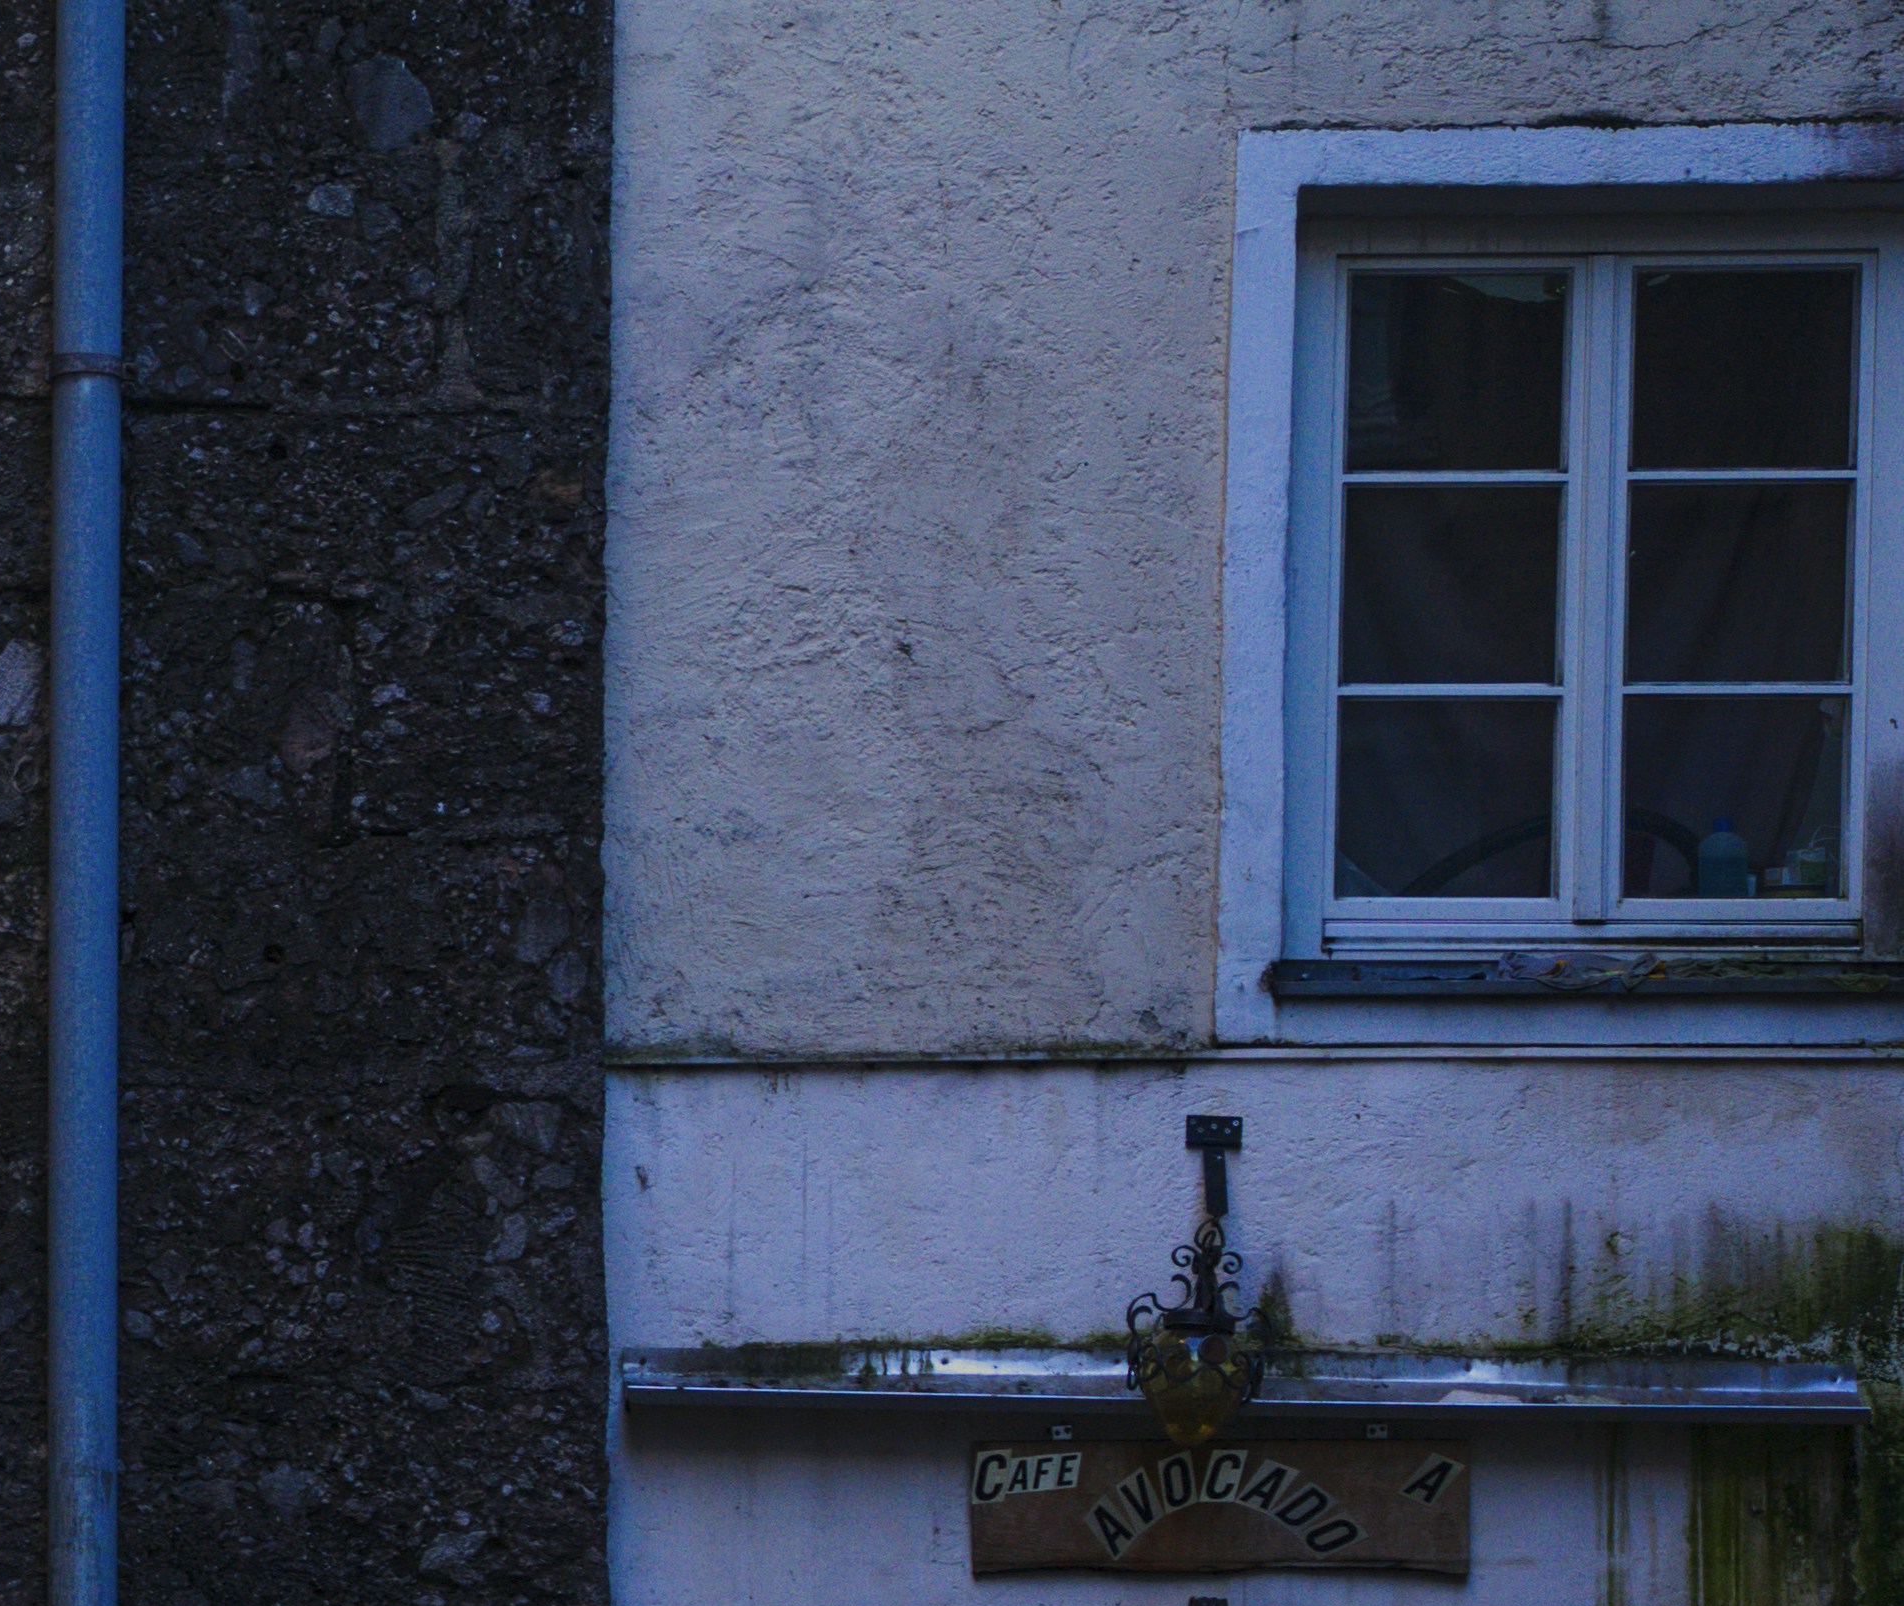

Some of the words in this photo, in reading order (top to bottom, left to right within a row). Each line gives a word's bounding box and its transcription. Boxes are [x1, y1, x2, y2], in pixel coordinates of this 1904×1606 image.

[974, 1452, 1078, 1502] CAFE
[1402, 1458, 1453, 1504] A
[1092, 1451, 1360, 1557] AVOCADO
